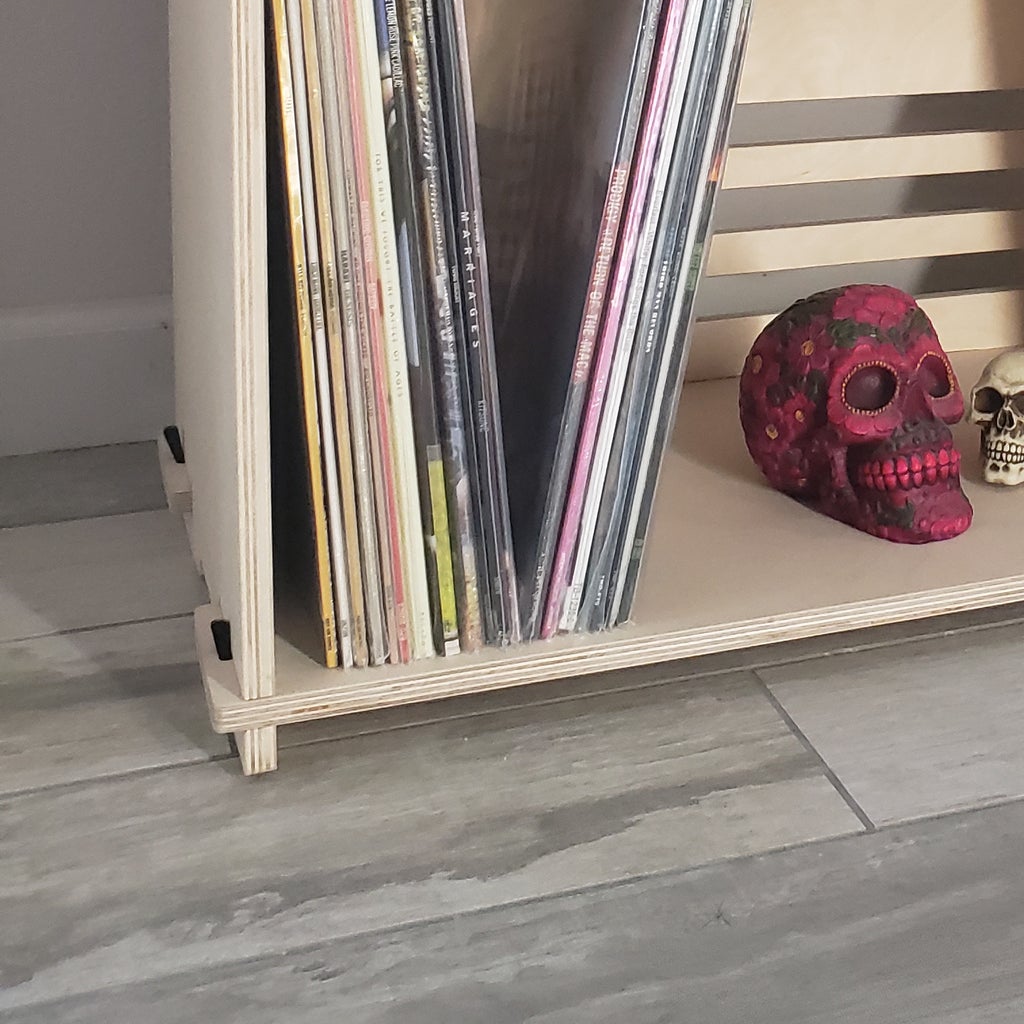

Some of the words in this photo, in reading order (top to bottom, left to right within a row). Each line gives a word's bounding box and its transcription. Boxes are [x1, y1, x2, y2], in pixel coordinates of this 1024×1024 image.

[386, 2, 397, 25] LEMON
[388, 25, 399, 42] ROSE
[390, 43, 400, 59] PINK
[392, 58, 403, 88] CADILLAC
[604, 167, 627, 223] PRODIGY
[459, 210, 481, 348] MARRIAGES
[588, 289, 603, 306] OF
[582, 312, 599, 337] THE
